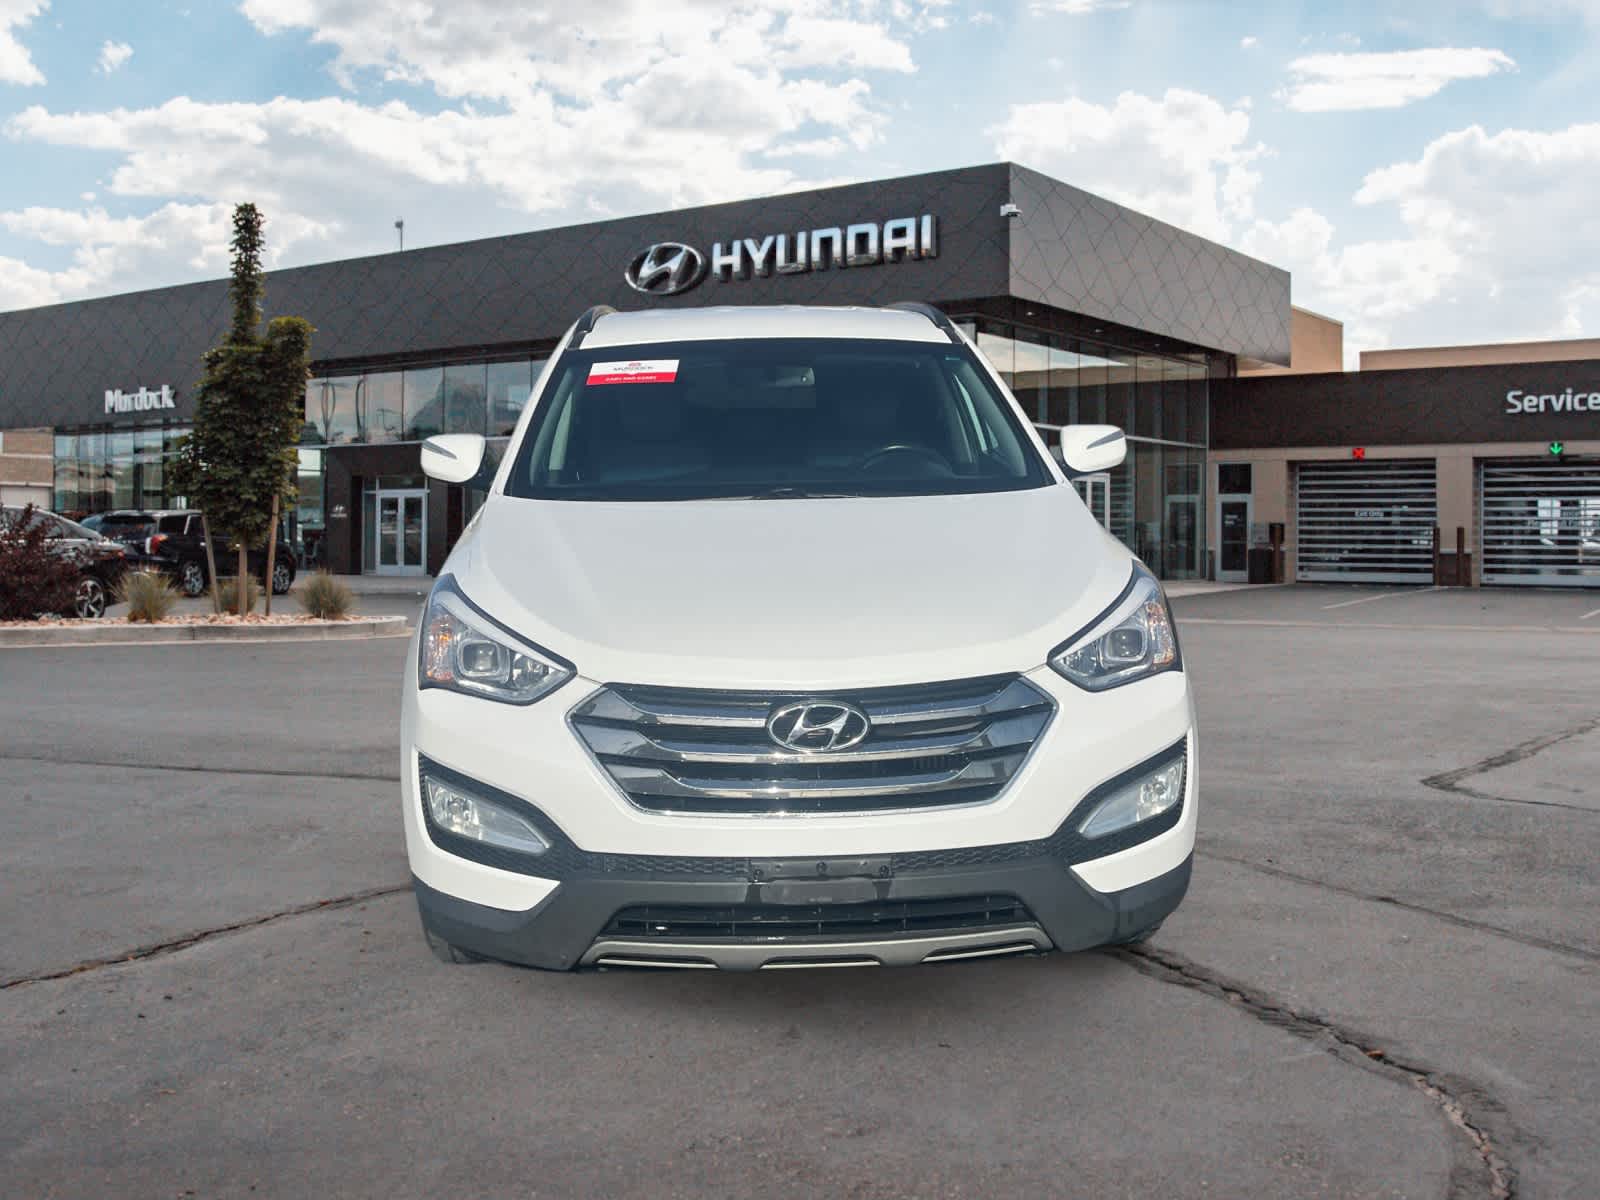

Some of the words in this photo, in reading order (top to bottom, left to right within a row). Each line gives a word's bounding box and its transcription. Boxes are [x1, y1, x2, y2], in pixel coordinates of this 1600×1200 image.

[712, 214, 937, 282] HYUNDAI
[104, 384, 176, 414] Murdock
[1505, 387, 1600, 414] Service
